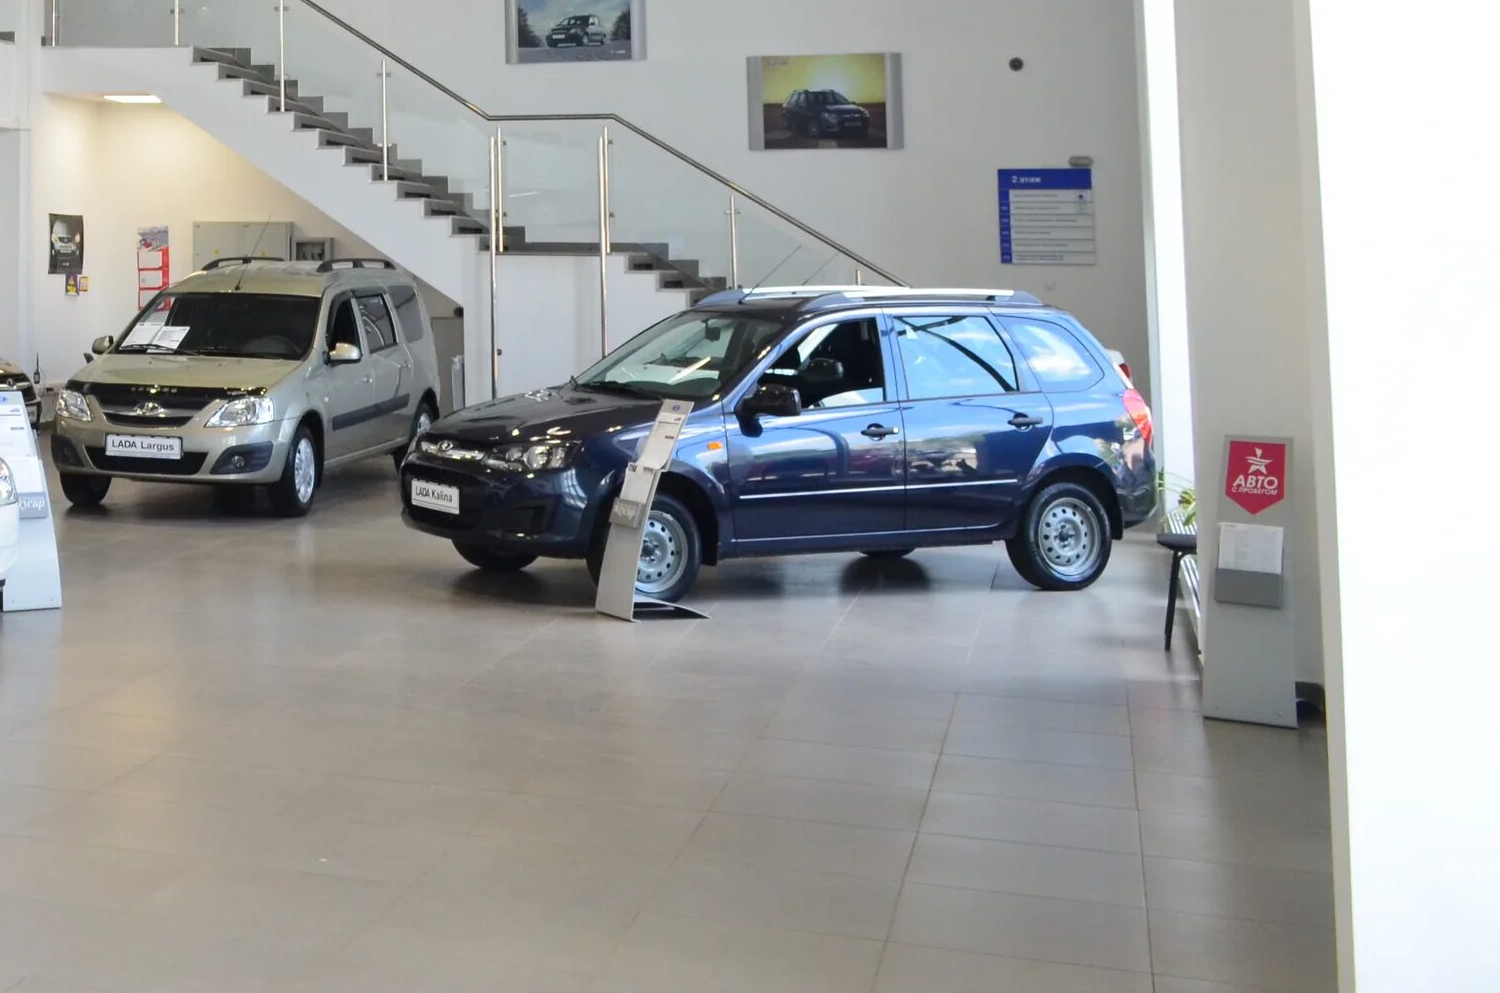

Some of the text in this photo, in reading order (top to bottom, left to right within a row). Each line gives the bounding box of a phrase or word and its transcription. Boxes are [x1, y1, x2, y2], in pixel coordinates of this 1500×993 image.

[1011, 175, 1018, 183] 2
[112, 439, 175, 452] LADA Largus
[1232, 474, 1279, 489] АВТО
[415, 486, 453, 503] LADA Kalina
